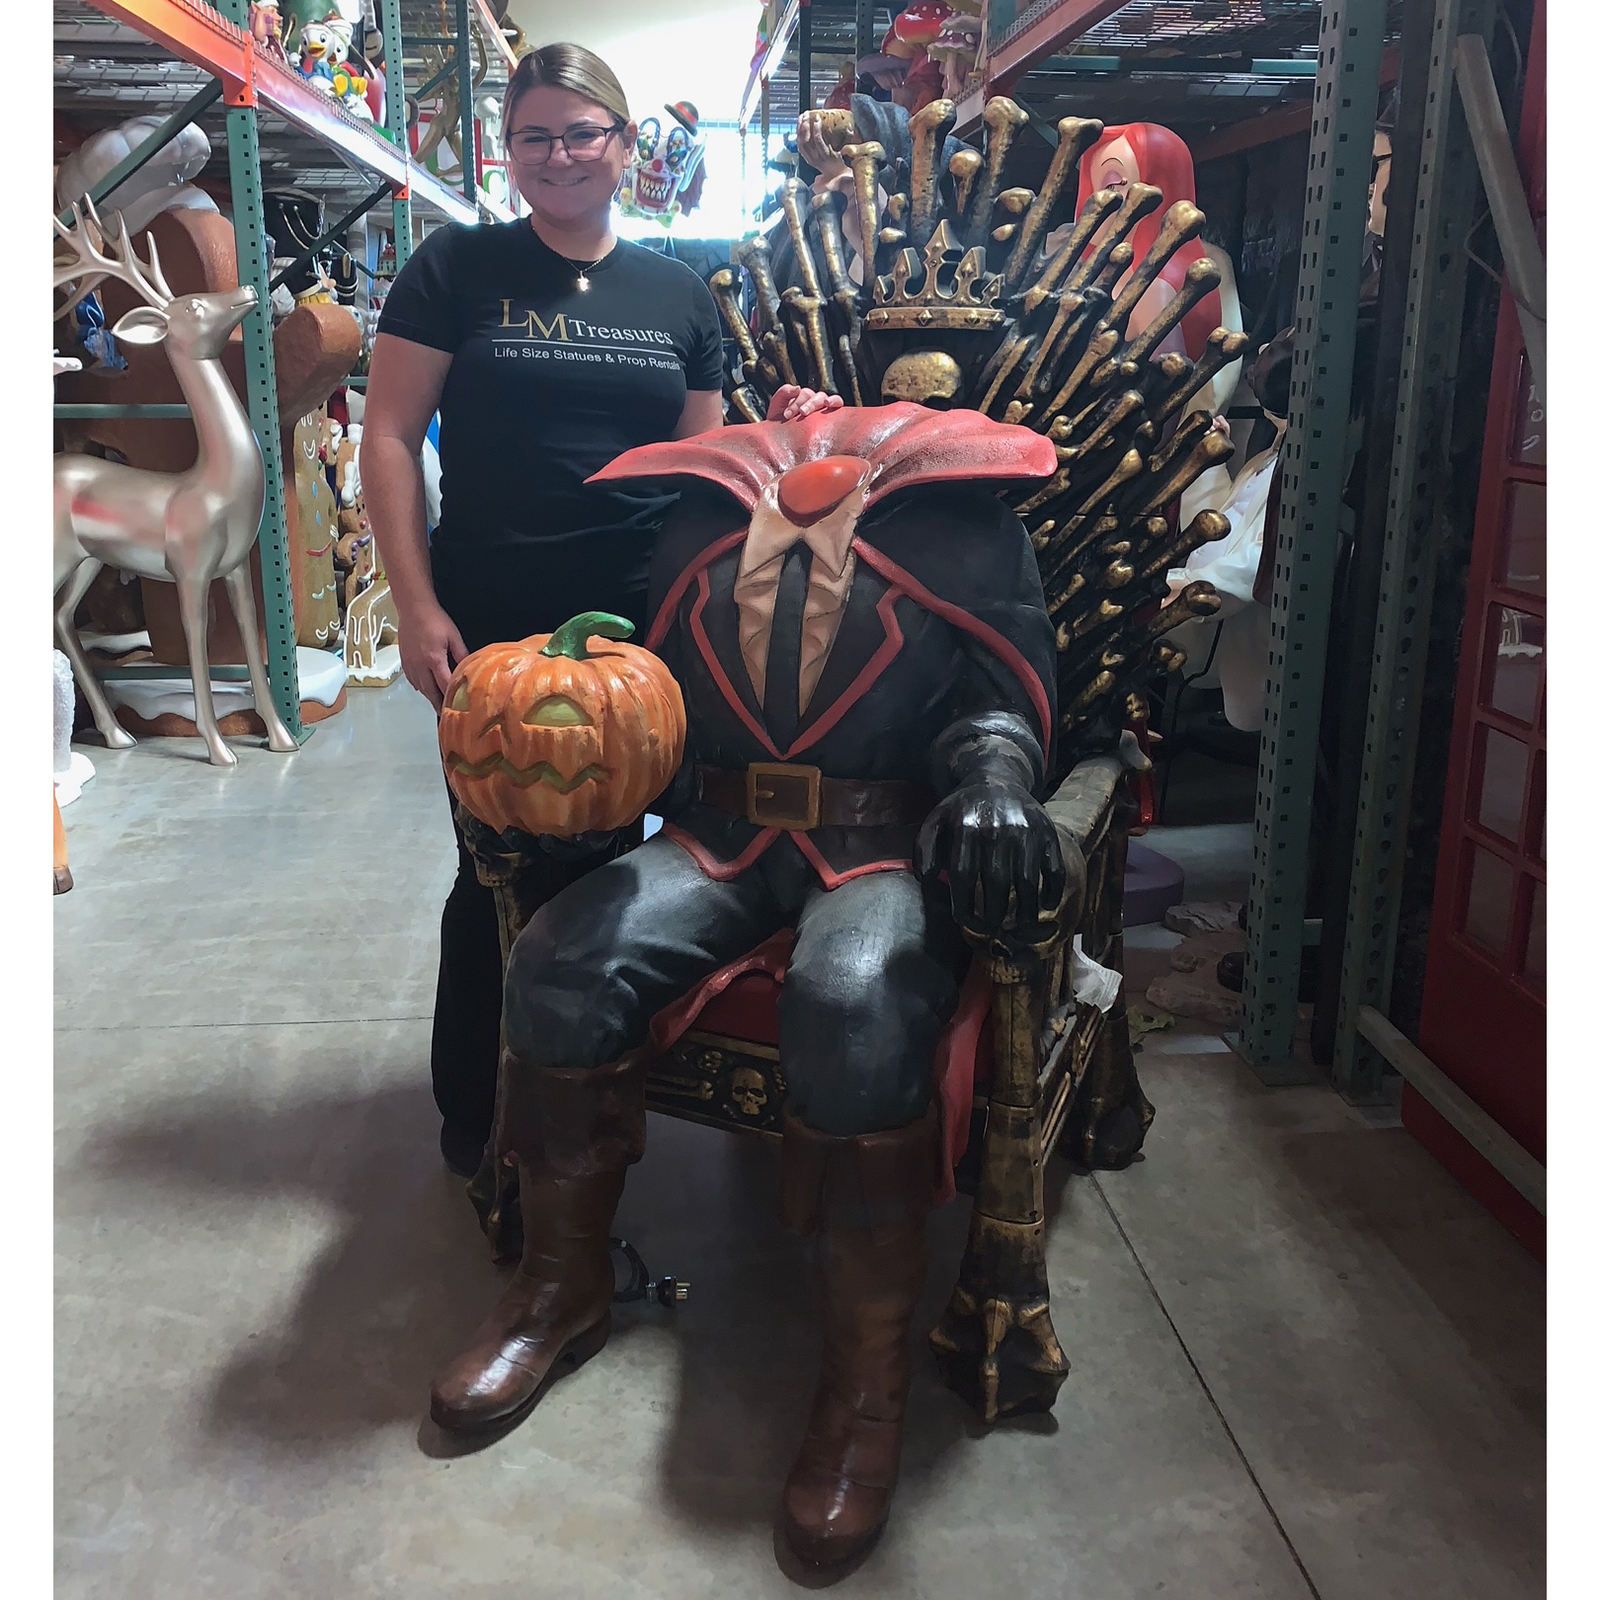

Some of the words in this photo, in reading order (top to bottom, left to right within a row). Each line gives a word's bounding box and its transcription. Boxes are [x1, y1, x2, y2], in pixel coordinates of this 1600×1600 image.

[498, 298, 573, 342] LM
[568, 318, 674, 345] Treasures
[494, 347, 518, 358] Life
[522, 347, 550, 359] Size
[553, 349, 602, 362] Statues
[605, 353, 615, 363] &
[617, 354, 646, 368] Prop
[648, 357, 681, 371] Rentals
